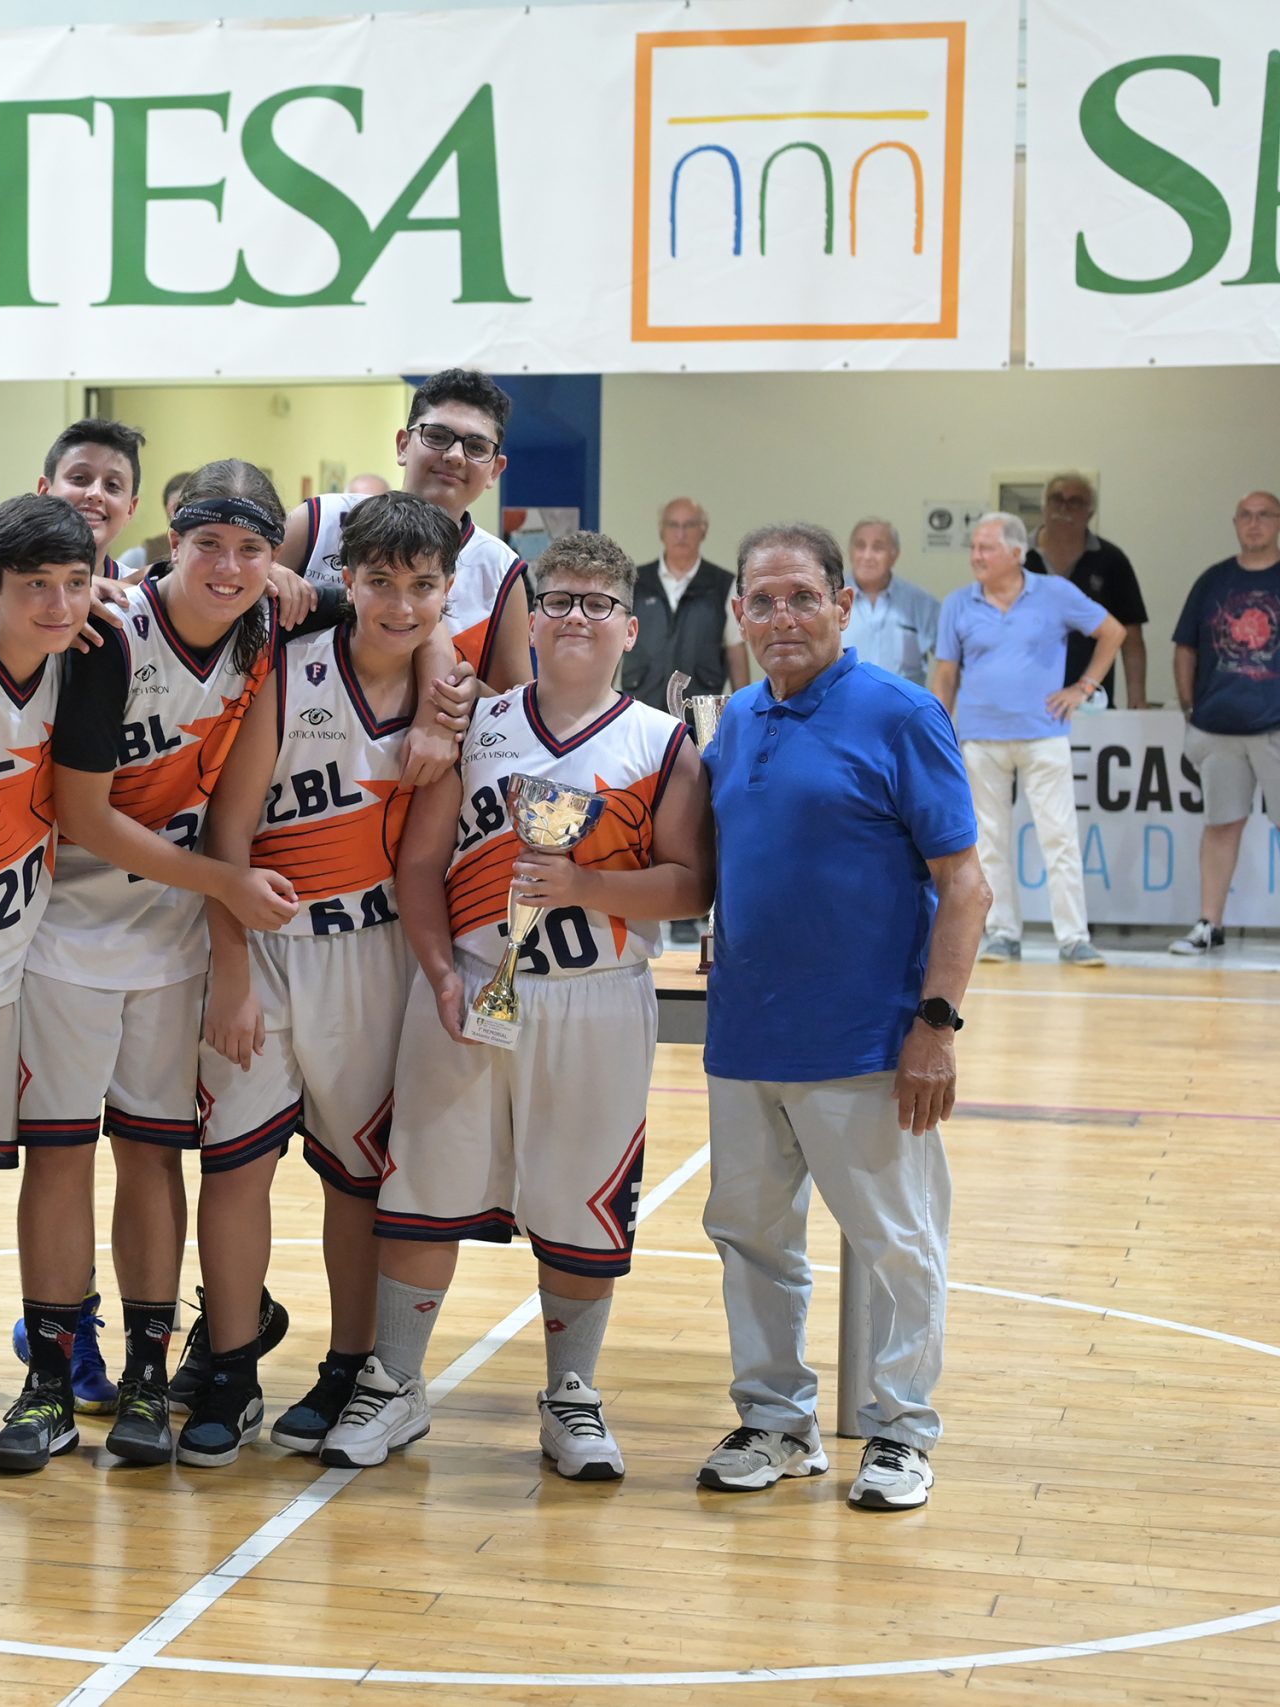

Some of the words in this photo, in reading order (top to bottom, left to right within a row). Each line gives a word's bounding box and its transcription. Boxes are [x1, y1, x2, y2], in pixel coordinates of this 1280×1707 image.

[1075, 49, 1280, 294] S
[317, 731, 346, 740] VISION
[489, 751, 520, 759] VISION
[266, 761, 363, 825] LBL
[566, 1381, 580, 1390] 23
